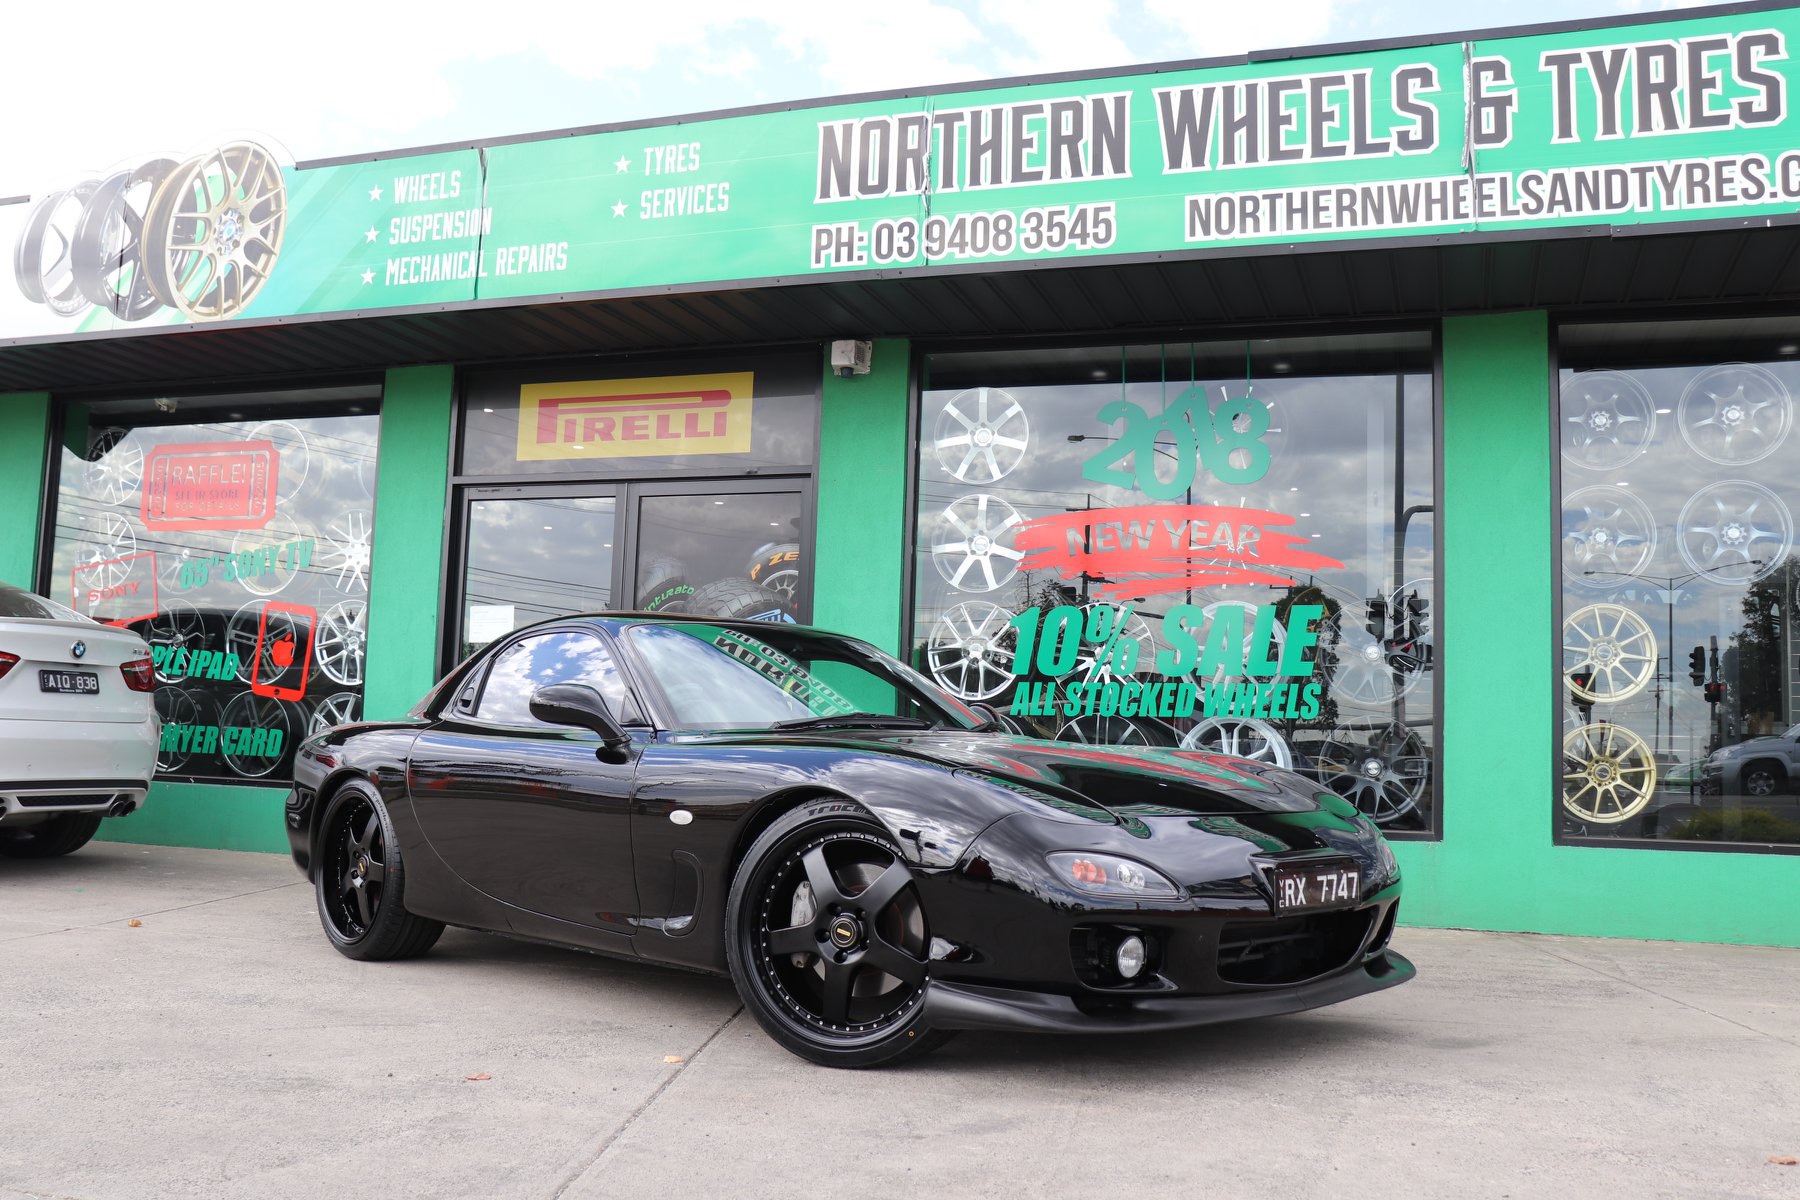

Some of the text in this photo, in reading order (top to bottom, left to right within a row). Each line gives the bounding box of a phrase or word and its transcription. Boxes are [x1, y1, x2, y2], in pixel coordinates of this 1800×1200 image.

[815, 31, 1786, 203] NORTHERN WHEELS & TYRES
[643, 142, 701, 176] TYRES
[394, 170, 461, 204] WHEELS
[639, 182, 730, 220] SERVICES
[389, 207, 493, 245] SUSPENSION
[813, 203, 1114, 266] PH: 03 9408 3545
[385, 241, 569, 286] MECHANICAL REPAIRS
[536, 389, 732, 444] PIRELLI
[1082, 384, 1272, 501] 2018
[171, 463, 247, 486] RAFFLE!
[209, 488, 240, 500] STORE
[1066, 518, 1262, 558] NEW YEAR
[223, 544, 282, 582] SONY
[284, 537, 316, 573] TV
[87, 580, 142, 604] SONY
[1010, 602, 1324, 678] 10% SALE
[150, 645, 188, 675] PLE
[1010, 682, 1322, 721] ALL STOCKED WHEELS
[160, 723, 284, 758] MYER CARD
[1284, 871, 1358, 907] RX 7747
